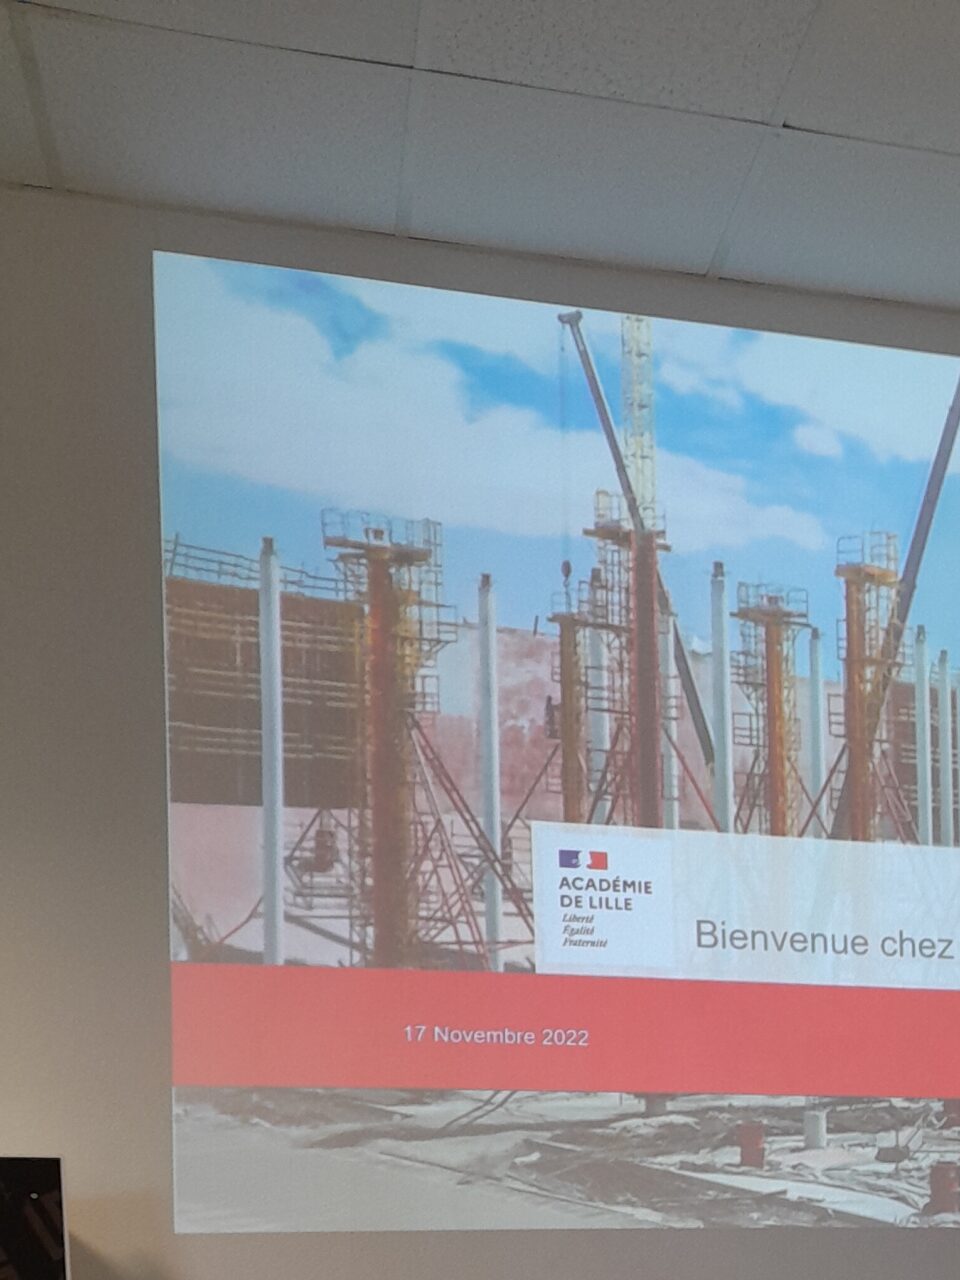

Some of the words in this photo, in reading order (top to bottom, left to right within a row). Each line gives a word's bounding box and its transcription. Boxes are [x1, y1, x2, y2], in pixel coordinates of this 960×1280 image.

[559, 876, 652, 894] ACADÉMIE
[560, 895, 583, 909] DE
[589, 896, 633, 911] LILLE
[562, 913, 594, 924] Liberté
[562, 937, 608, 948] Fraternité
[696, 919, 869, 956] Bienvenue
[880, 929, 955, 960] chez
[404, 1025, 426, 1041] 17
[433, 1026, 536, 1045] Novembre
[542, 1029, 589, 1046] 2022
